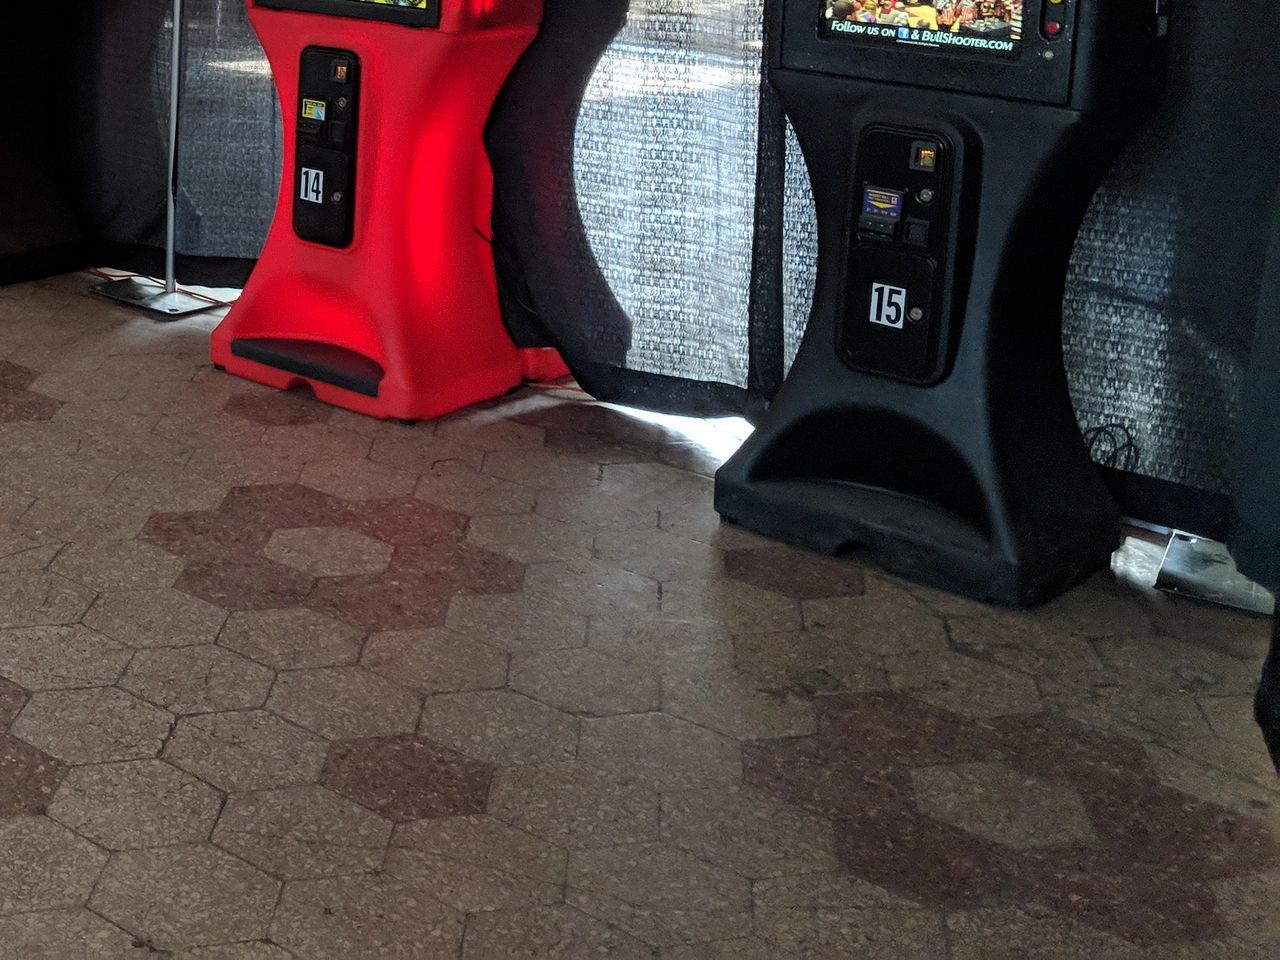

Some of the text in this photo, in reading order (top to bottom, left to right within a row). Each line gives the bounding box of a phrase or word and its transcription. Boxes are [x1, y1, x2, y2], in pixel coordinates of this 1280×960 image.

[831, 21, 866, 33] Follow
[911, 30, 919, 39] &
[302, 170, 321, 202] 14
[874, 286, 902, 325] 15
